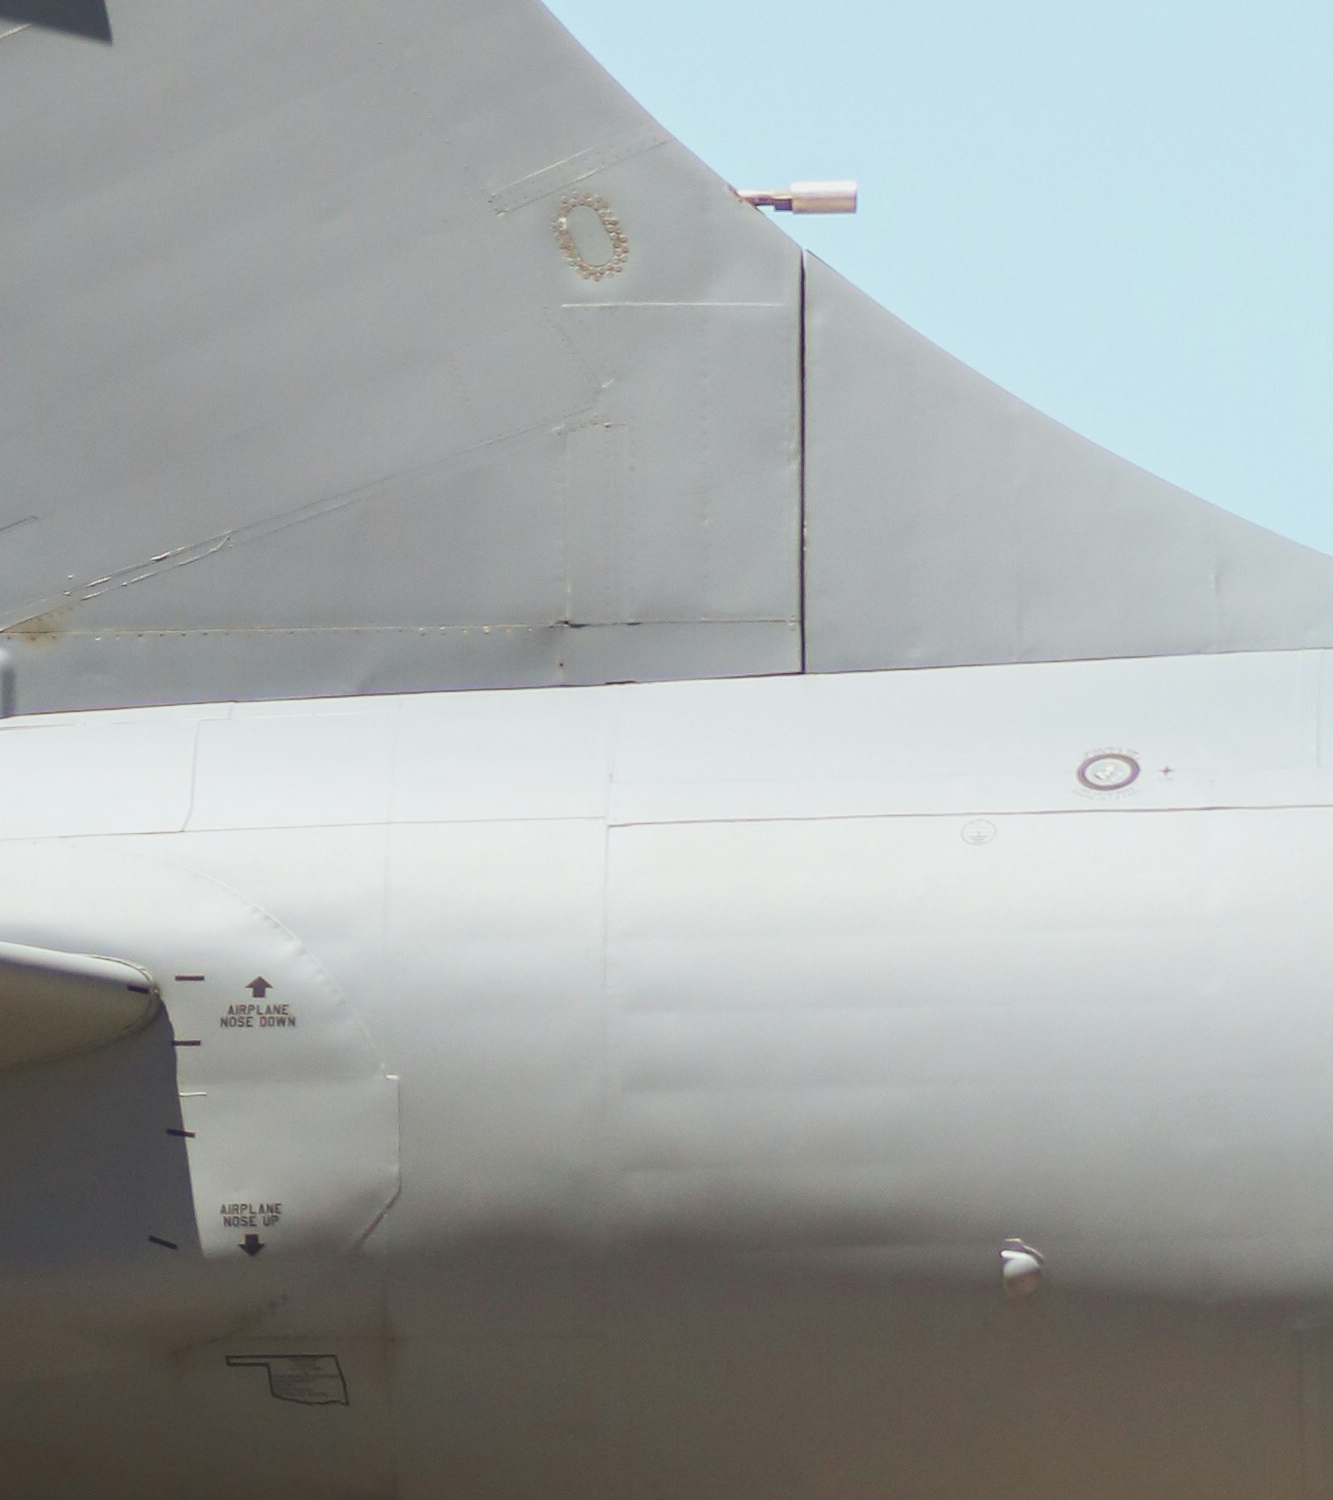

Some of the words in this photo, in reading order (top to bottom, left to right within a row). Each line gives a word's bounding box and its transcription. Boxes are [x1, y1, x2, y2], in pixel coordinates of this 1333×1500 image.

[227, 1004, 290, 1016] AIRPLANE
[220, 1016, 254, 1028] NOSE
[259, 1016, 297, 1028] DOWN
[220, 1203, 283, 1215] AIRPLANE
[223, 1215, 258, 1227] NOSE
[262, 1215, 280, 1227] UP
